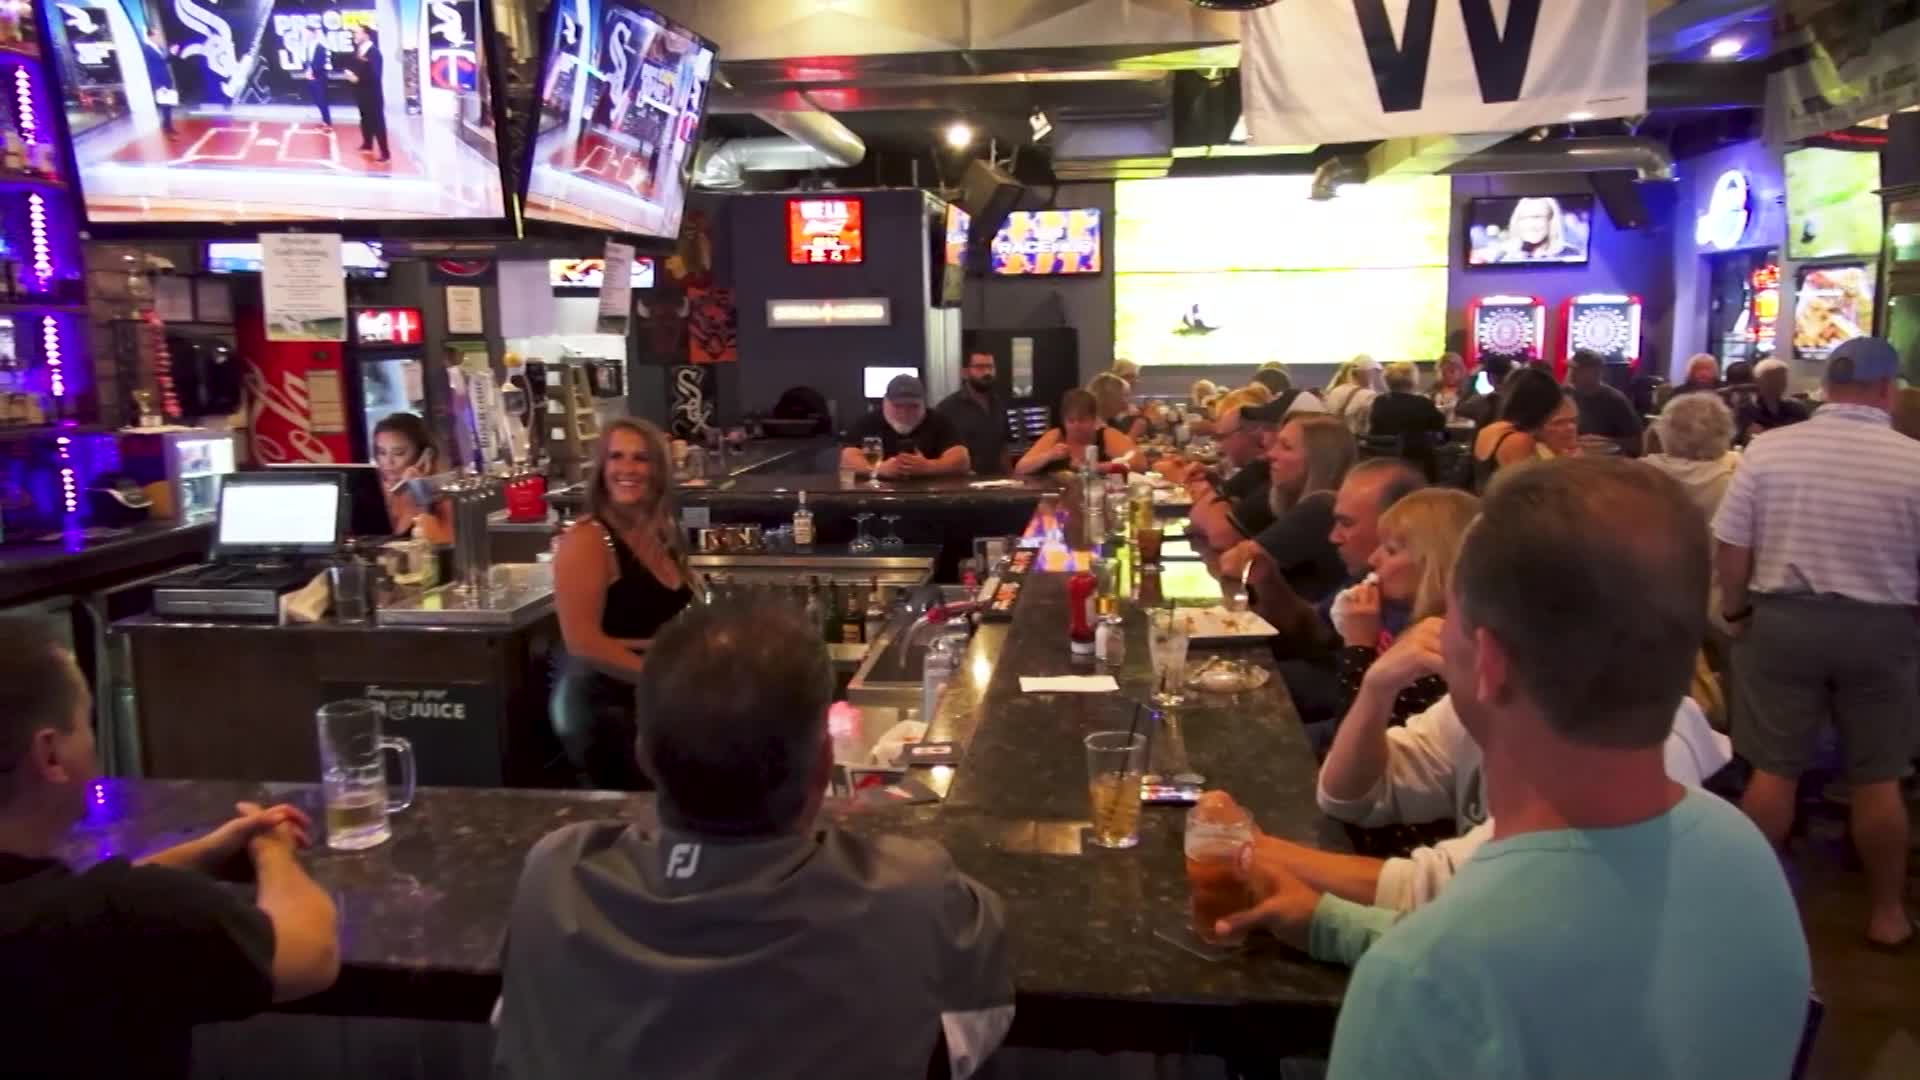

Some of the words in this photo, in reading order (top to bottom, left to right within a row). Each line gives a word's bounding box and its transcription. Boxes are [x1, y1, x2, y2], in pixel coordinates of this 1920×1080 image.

[1355, 0, 1541, 113] W
[410, 702, 466, 720] JUICE
[665, 843, 701, 879] FJ
